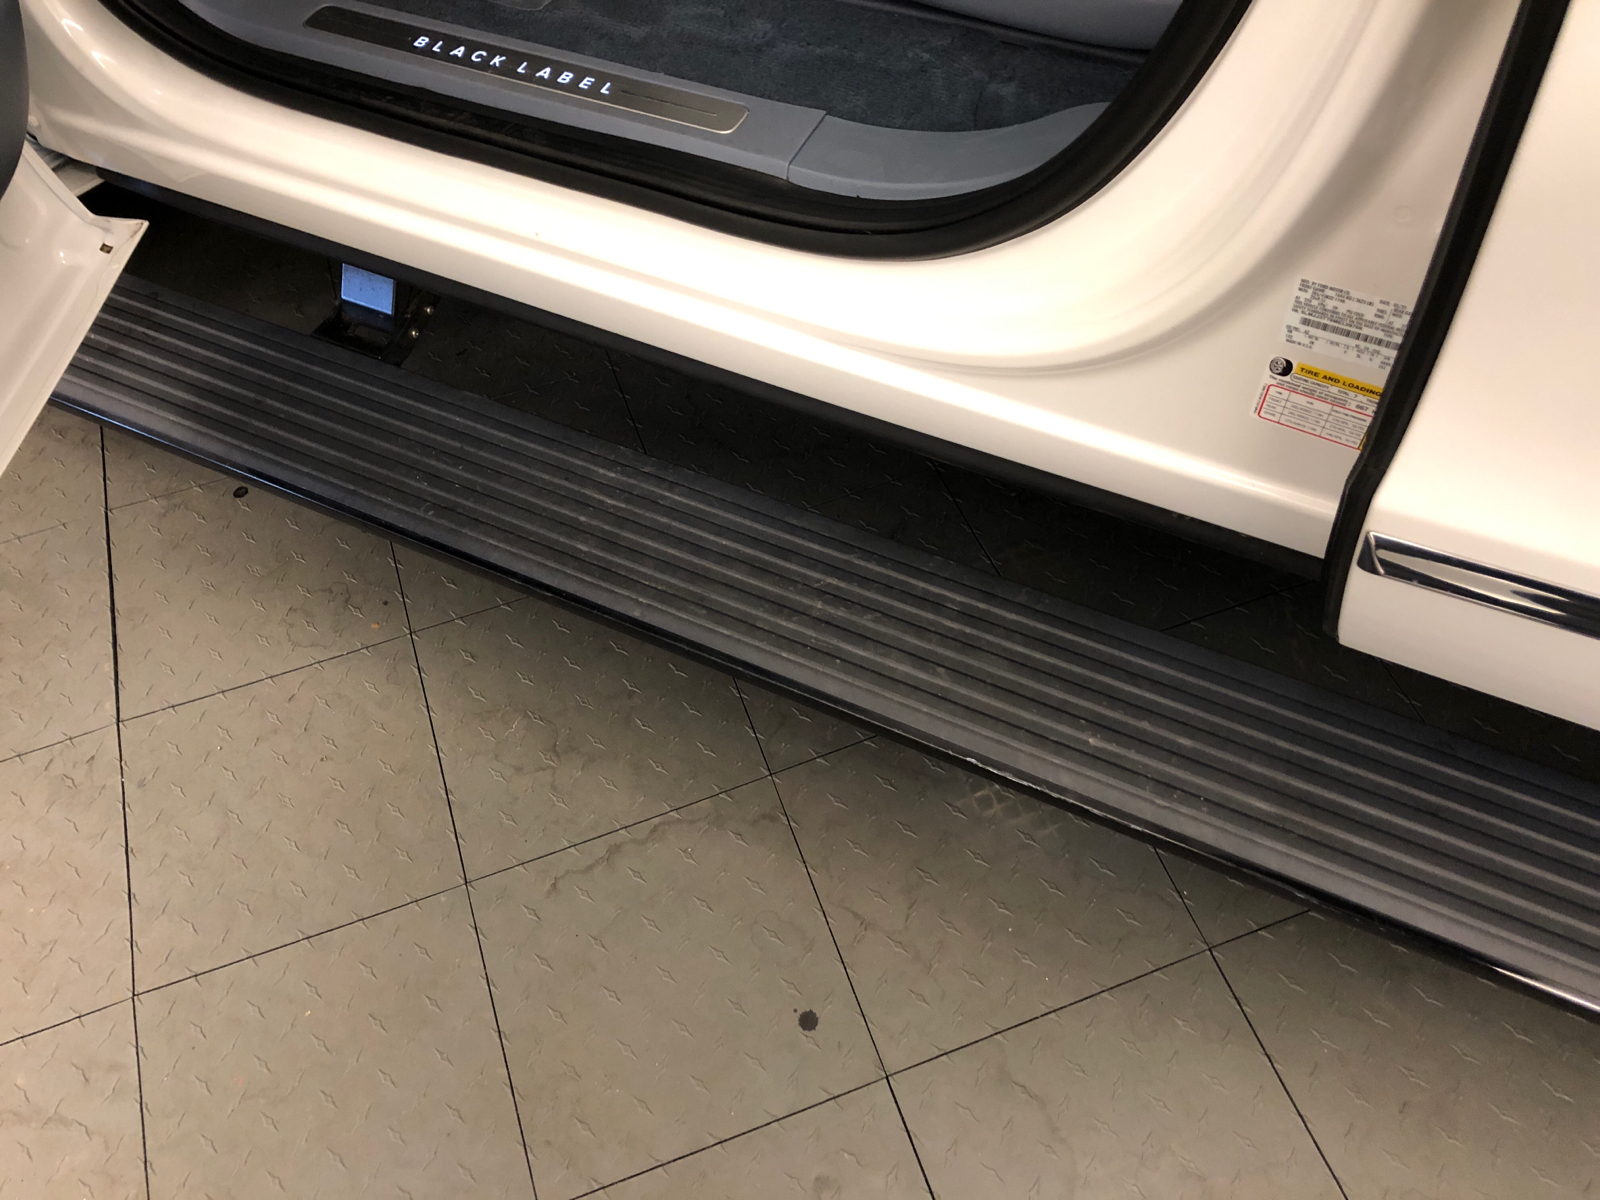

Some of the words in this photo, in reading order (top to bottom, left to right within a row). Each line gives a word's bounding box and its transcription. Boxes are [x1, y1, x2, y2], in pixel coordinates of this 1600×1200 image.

[413, 36, 507, 67] BLACK
[517, 61, 611, 95] LABEL
[1299, 367, 1320, 378] TIRE
[1321, 374, 1341, 384] AND
[1342, 381, 1382, 397] LOADING
